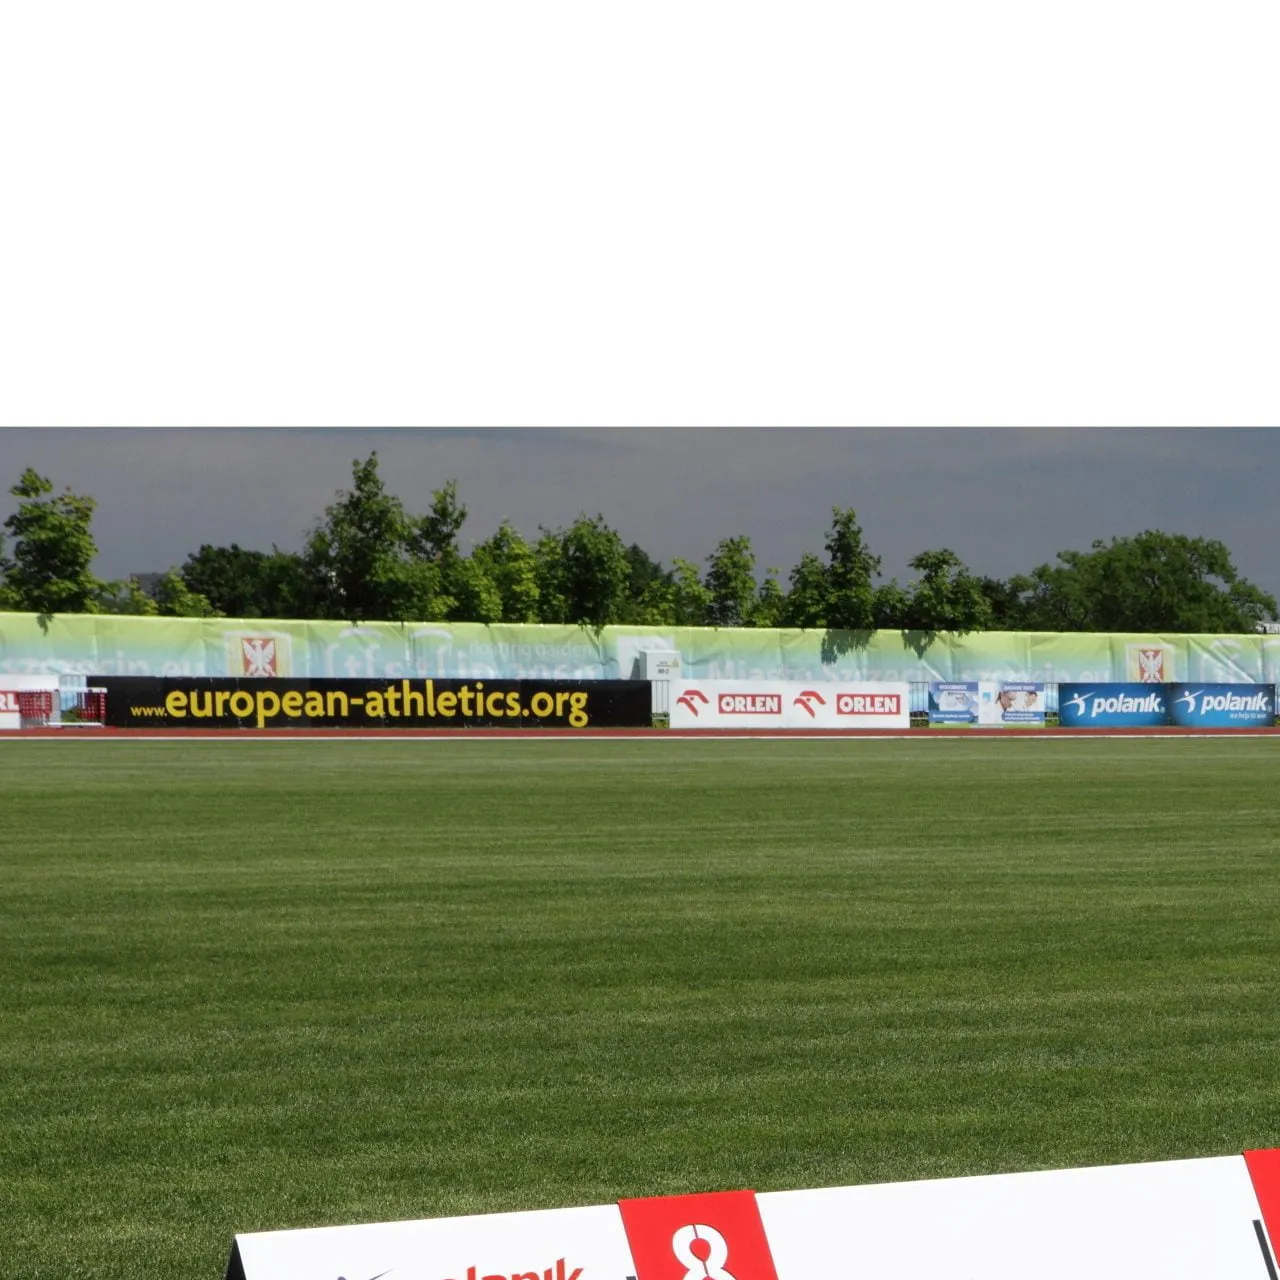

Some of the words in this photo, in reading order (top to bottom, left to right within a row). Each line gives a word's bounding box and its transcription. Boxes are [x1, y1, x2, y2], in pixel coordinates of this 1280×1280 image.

[131, 679, 589, 728] www.european-athletics.org
[720, 696, 780, 713] ORLEN
[839, 696, 898, 713] ORLEN
[1091, 692, 1162, 718] polanik
[1200, 691, 1268, 715] polanik
